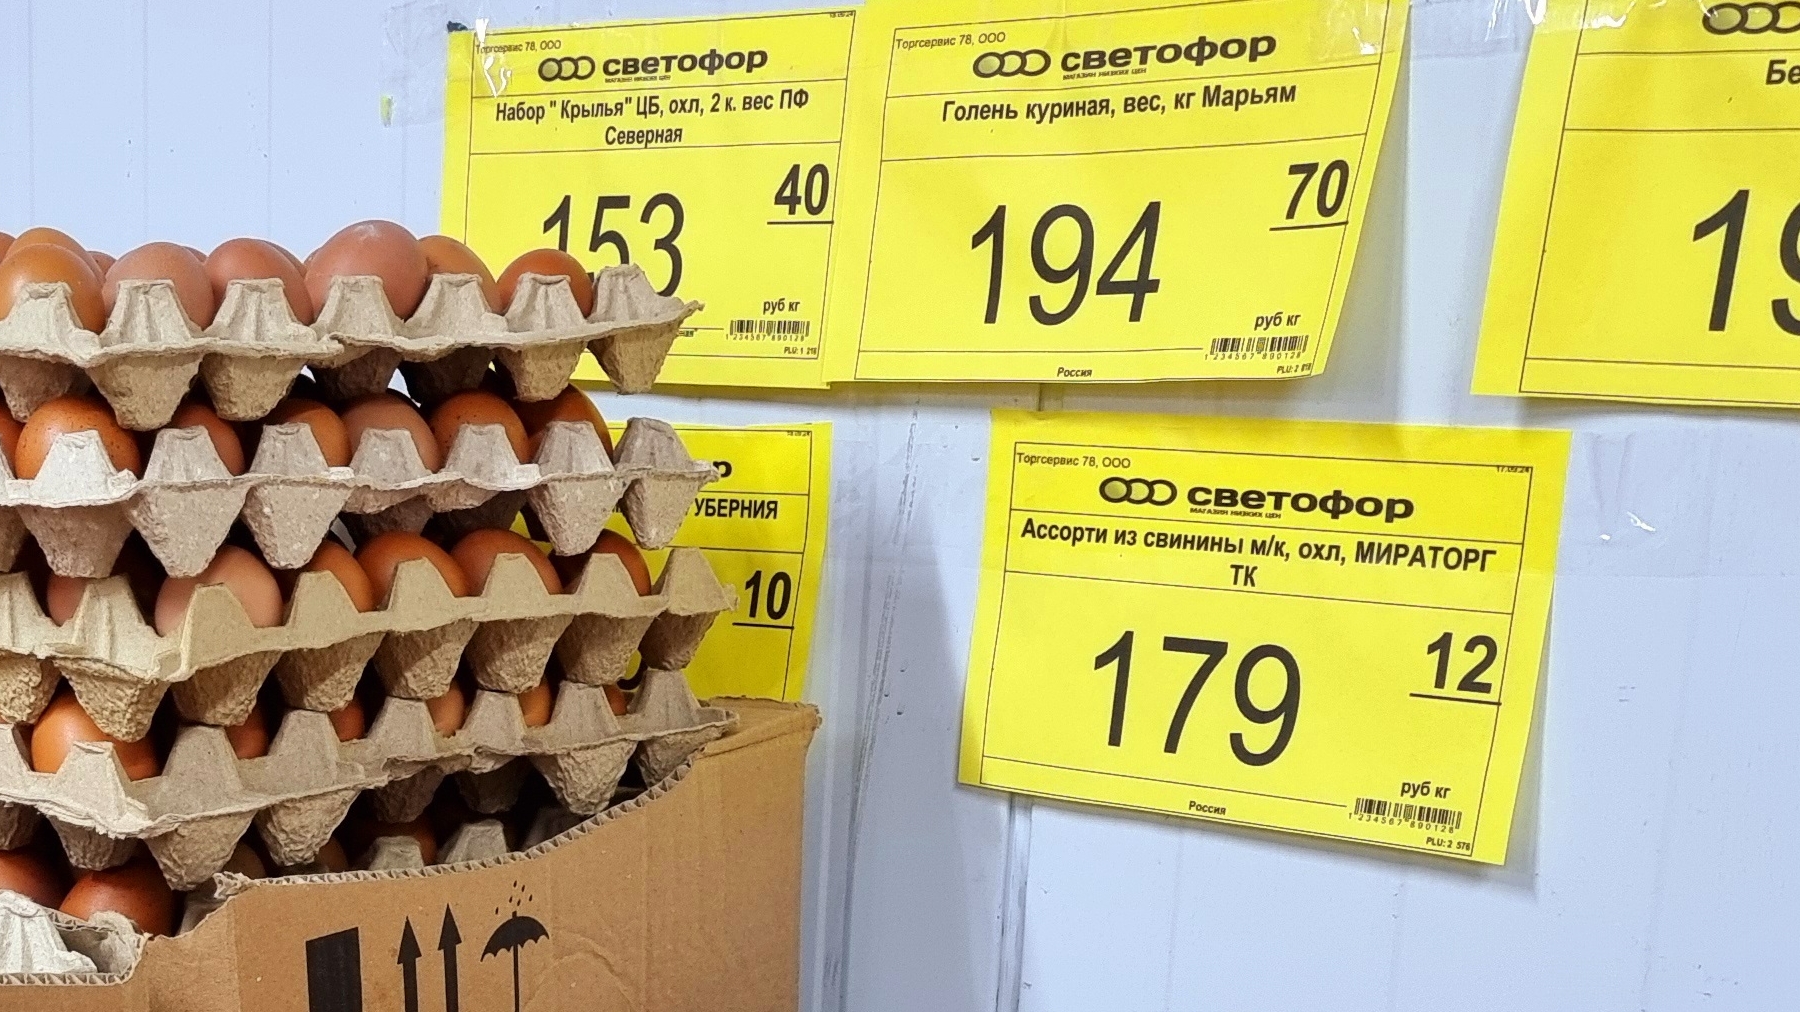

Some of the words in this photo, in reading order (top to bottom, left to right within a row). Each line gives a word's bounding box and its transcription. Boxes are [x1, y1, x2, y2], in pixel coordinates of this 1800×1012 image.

[540, 39, 562, 50] ООО
[895, 37, 956, 50] Торгсервис
[959, 33, 975, 46] 78,
[978, 31, 1006, 44] ООО
[1060, 36, 1277, 72] светофор
[602, 49, 768, 76] светофор
[495, 102, 546, 124] Набор
[636, 95, 664, 118] ЦБ,
[668, 97, 704, 116] охл,
[710, 92, 721, 113] 2
[724, 97, 737, 112] к.
[742, 95, 775, 111] вес
[779, 88, 810, 110] ПФ
[942, 101, 1018, 122] Голень
[1025, 98, 1116, 124] куриная,
[1123, 93, 1166, 117] вес,
[1173, 90, 1194, 112] кг
[1201, 84, 1296, 111] Марьям
[605, 126, 683, 149] Северная
[773, 163, 830, 217] 40
[1285, 159, 1350, 221] 70
[542, 192, 685, 298] 153
[970, 200, 1162, 326] 194
[762, 297, 786, 315] руб
[788, 300, 801, 312] кг
[1253, 311, 1284, 331] руб
[1286, 313, 1302, 327] кг
[1057, 366, 1093, 378] Россия
[1016, 452, 1079, 468] Торгсервис
[1082, 456, 1099, 469] 78,
[1102, 456, 1131, 469] ООО
[694, 497, 779, 520] УБЕРНИЯ
[1186, 485, 1415, 523] светофор
[1021, 518, 1108, 546] Ассорти
[1113, 529, 1137, 546] из
[1143, 530, 1244, 554] свинины
[1249, 534, 1291, 562] м/к,
[1298, 541, 1347, 567] охл,
[1354, 540, 1498, 574] МИРАТОРГ
[1229, 563, 1259, 588] ТК
[744, 569, 792, 621] 10
[1425, 631, 1499, 694] 12
[1093, 629, 1301, 768] 179
[1400, 780, 1432, 799] руб
[1434, 785, 1452, 799] кг
[1188, 800, 1227, 816] Россия
[1358, 814, 1403, 827] 234567
